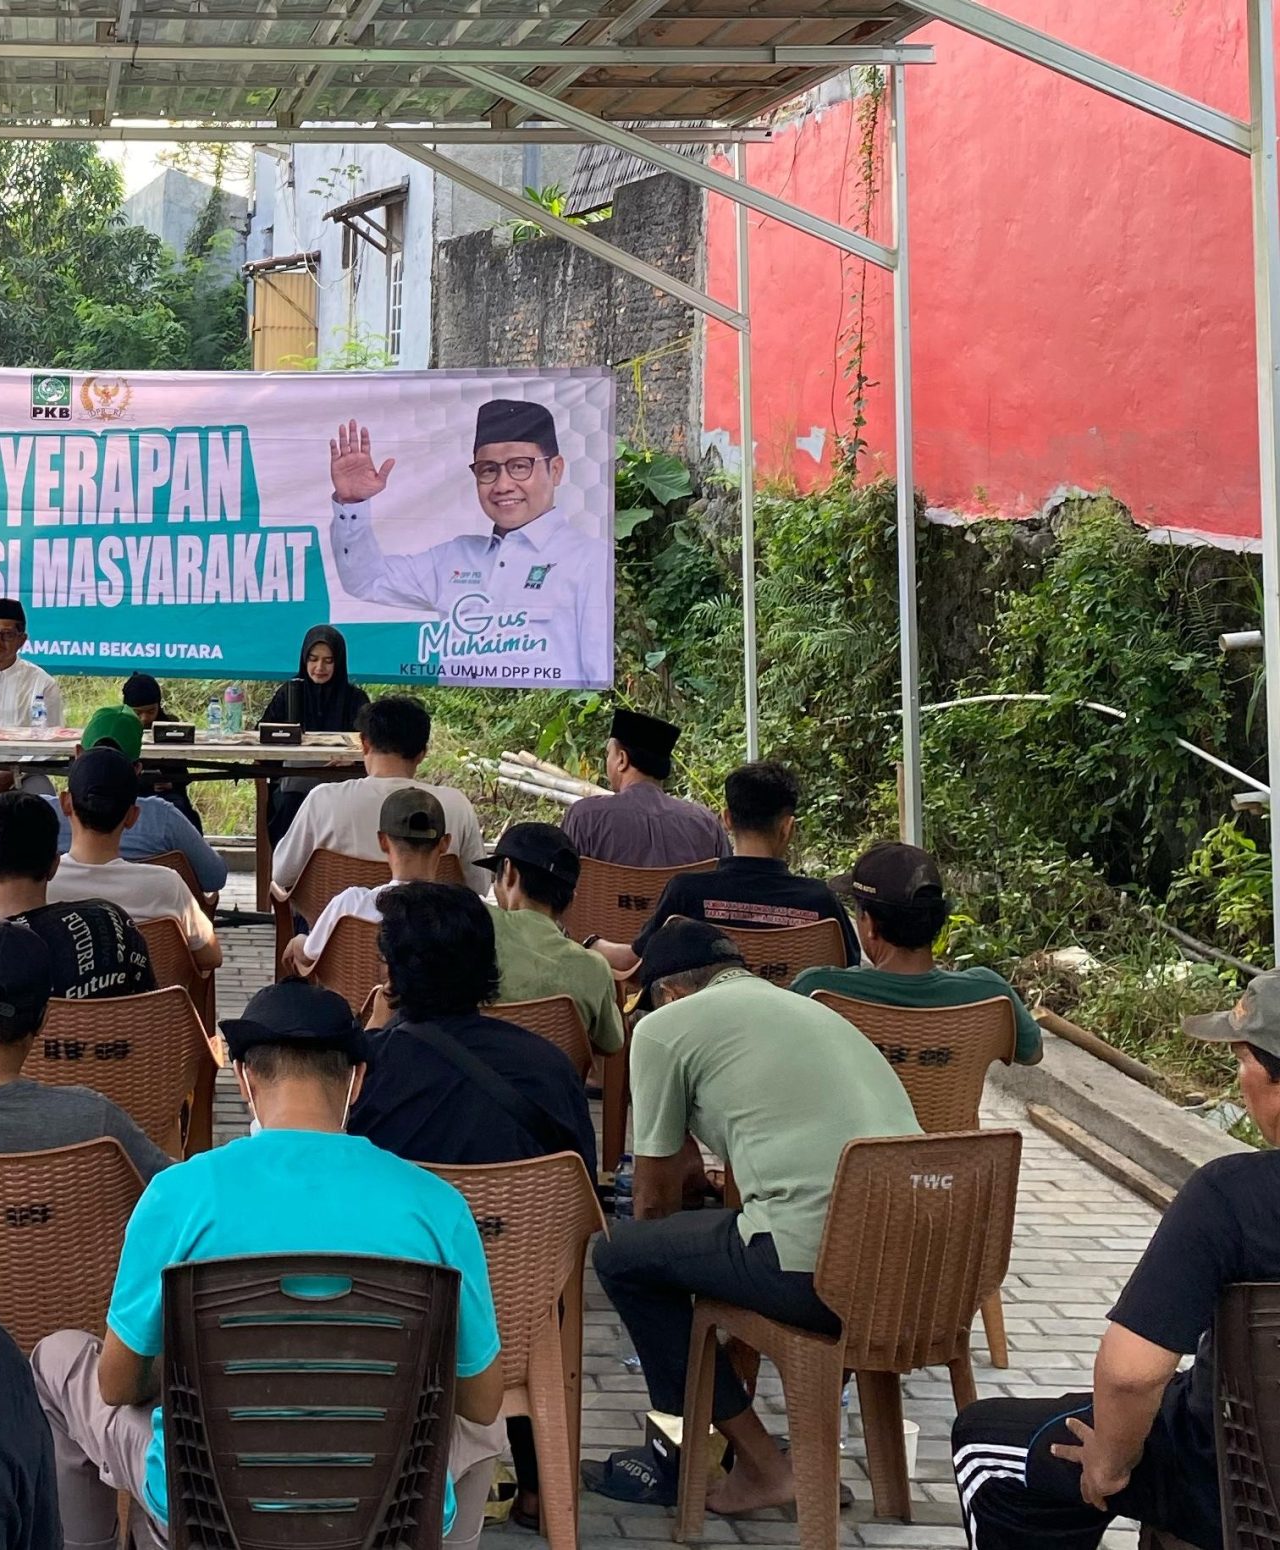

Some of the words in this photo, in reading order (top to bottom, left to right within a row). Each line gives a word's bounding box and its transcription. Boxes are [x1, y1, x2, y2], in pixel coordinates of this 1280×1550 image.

[32, 407, 70, 418] PKB
[32, 532, 312, 608] MASYARAKAT
[452, 593, 528, 635] Gus
[19, 640, 95, 656] AMATAN
[99, 642, 161, 658] BEKASI
[165, 643, 224, 659] UTARA
[420, 622, 547, 660] Muhaimin
[400, 663, 446, 677] KETUA
[451, 666, 498, 678] UMUM
[502, 666, 530, 678] DPP
[534, 667, 562, 679] PKB
[61, 911, 95, 976] FUTURE
[65, 972, 126, 999] Future
[616, 1459, 658, 1488] super
